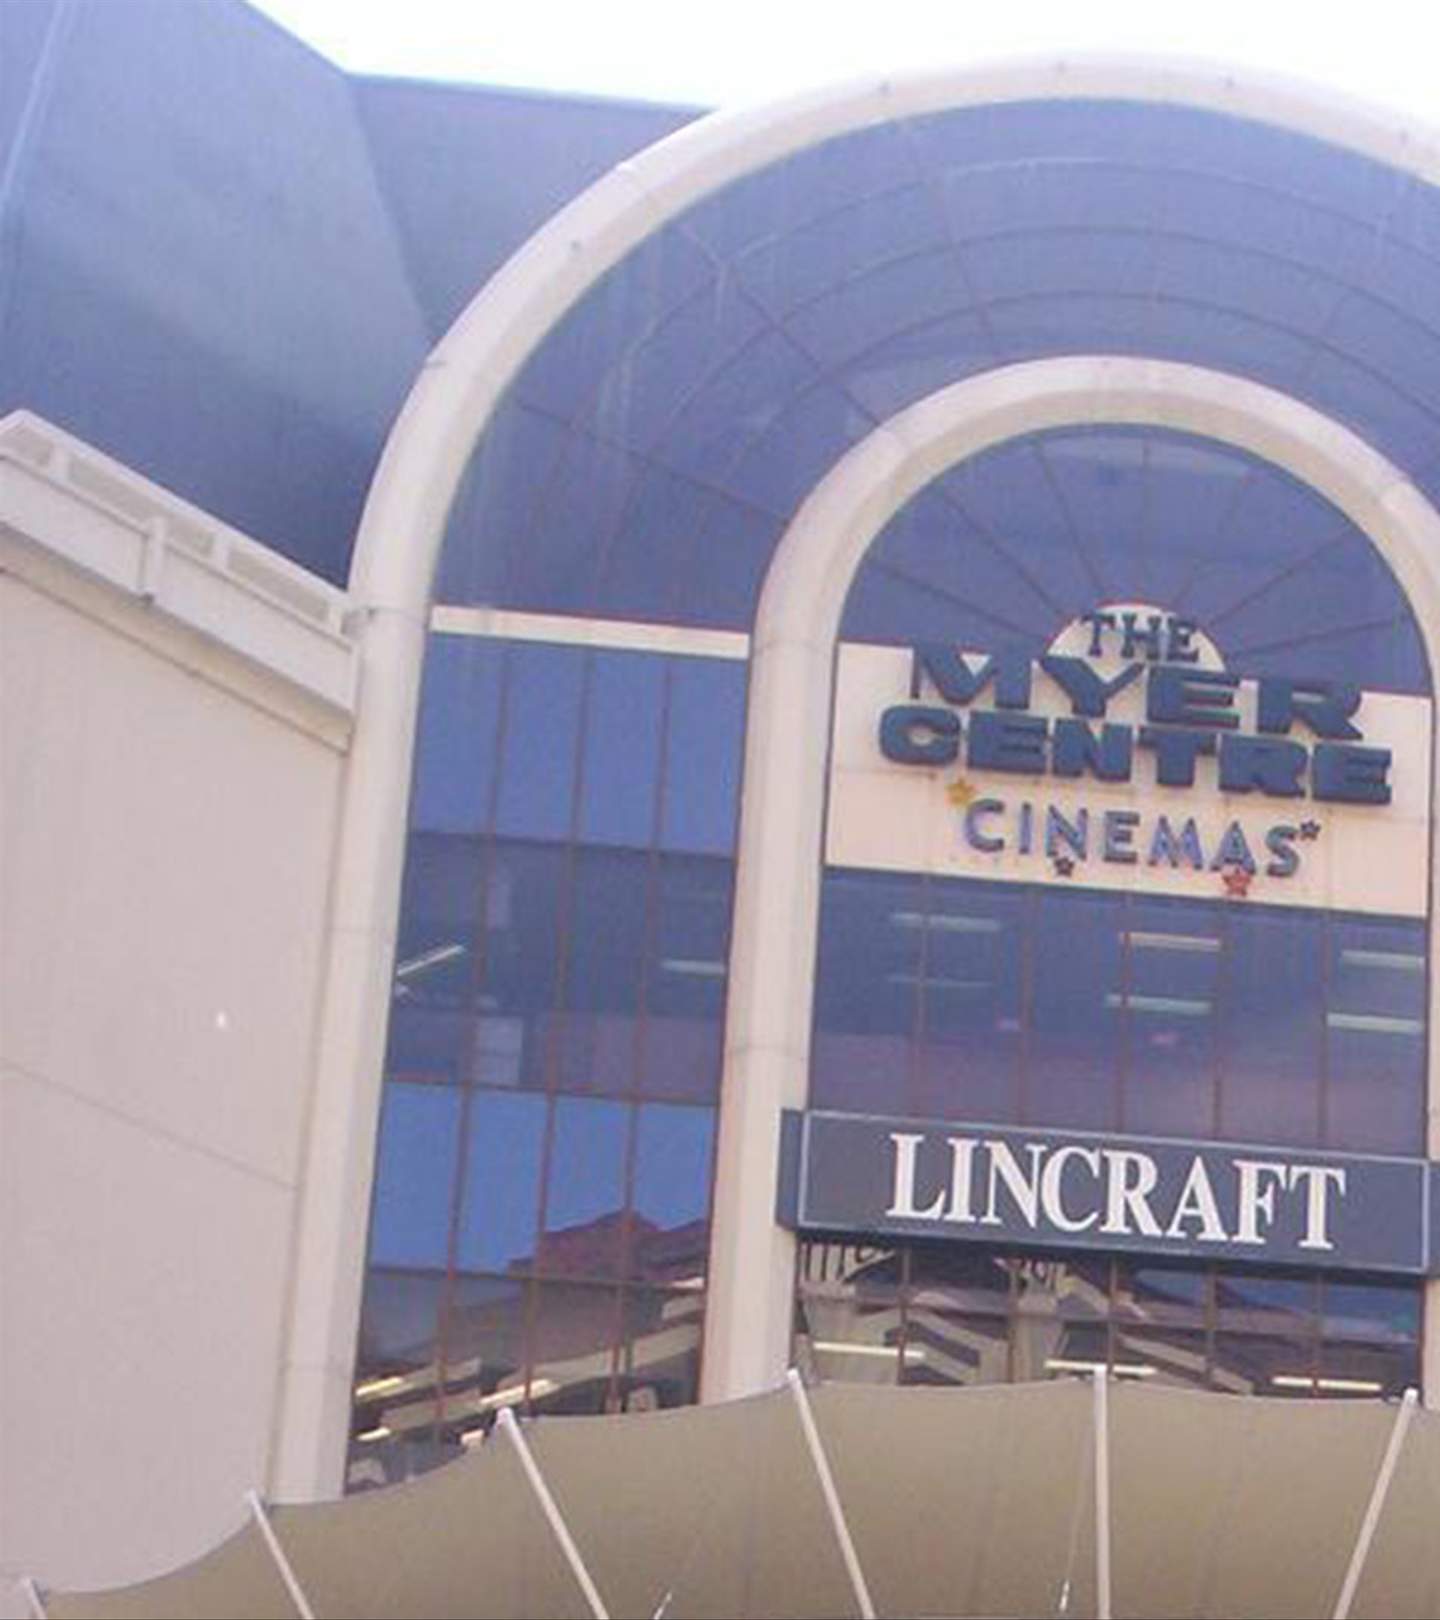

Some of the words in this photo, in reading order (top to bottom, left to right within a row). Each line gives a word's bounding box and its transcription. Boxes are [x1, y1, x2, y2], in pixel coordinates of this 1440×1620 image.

[1080, 612, 1201, 663] THE
[910, 641, 1364, 741] MYER
[878, 704, 1393, 805] CENTRE
[963, 798, 1302, 878] CINEMAS
[885, 1132, 1347, 1250] LINCRAFT
